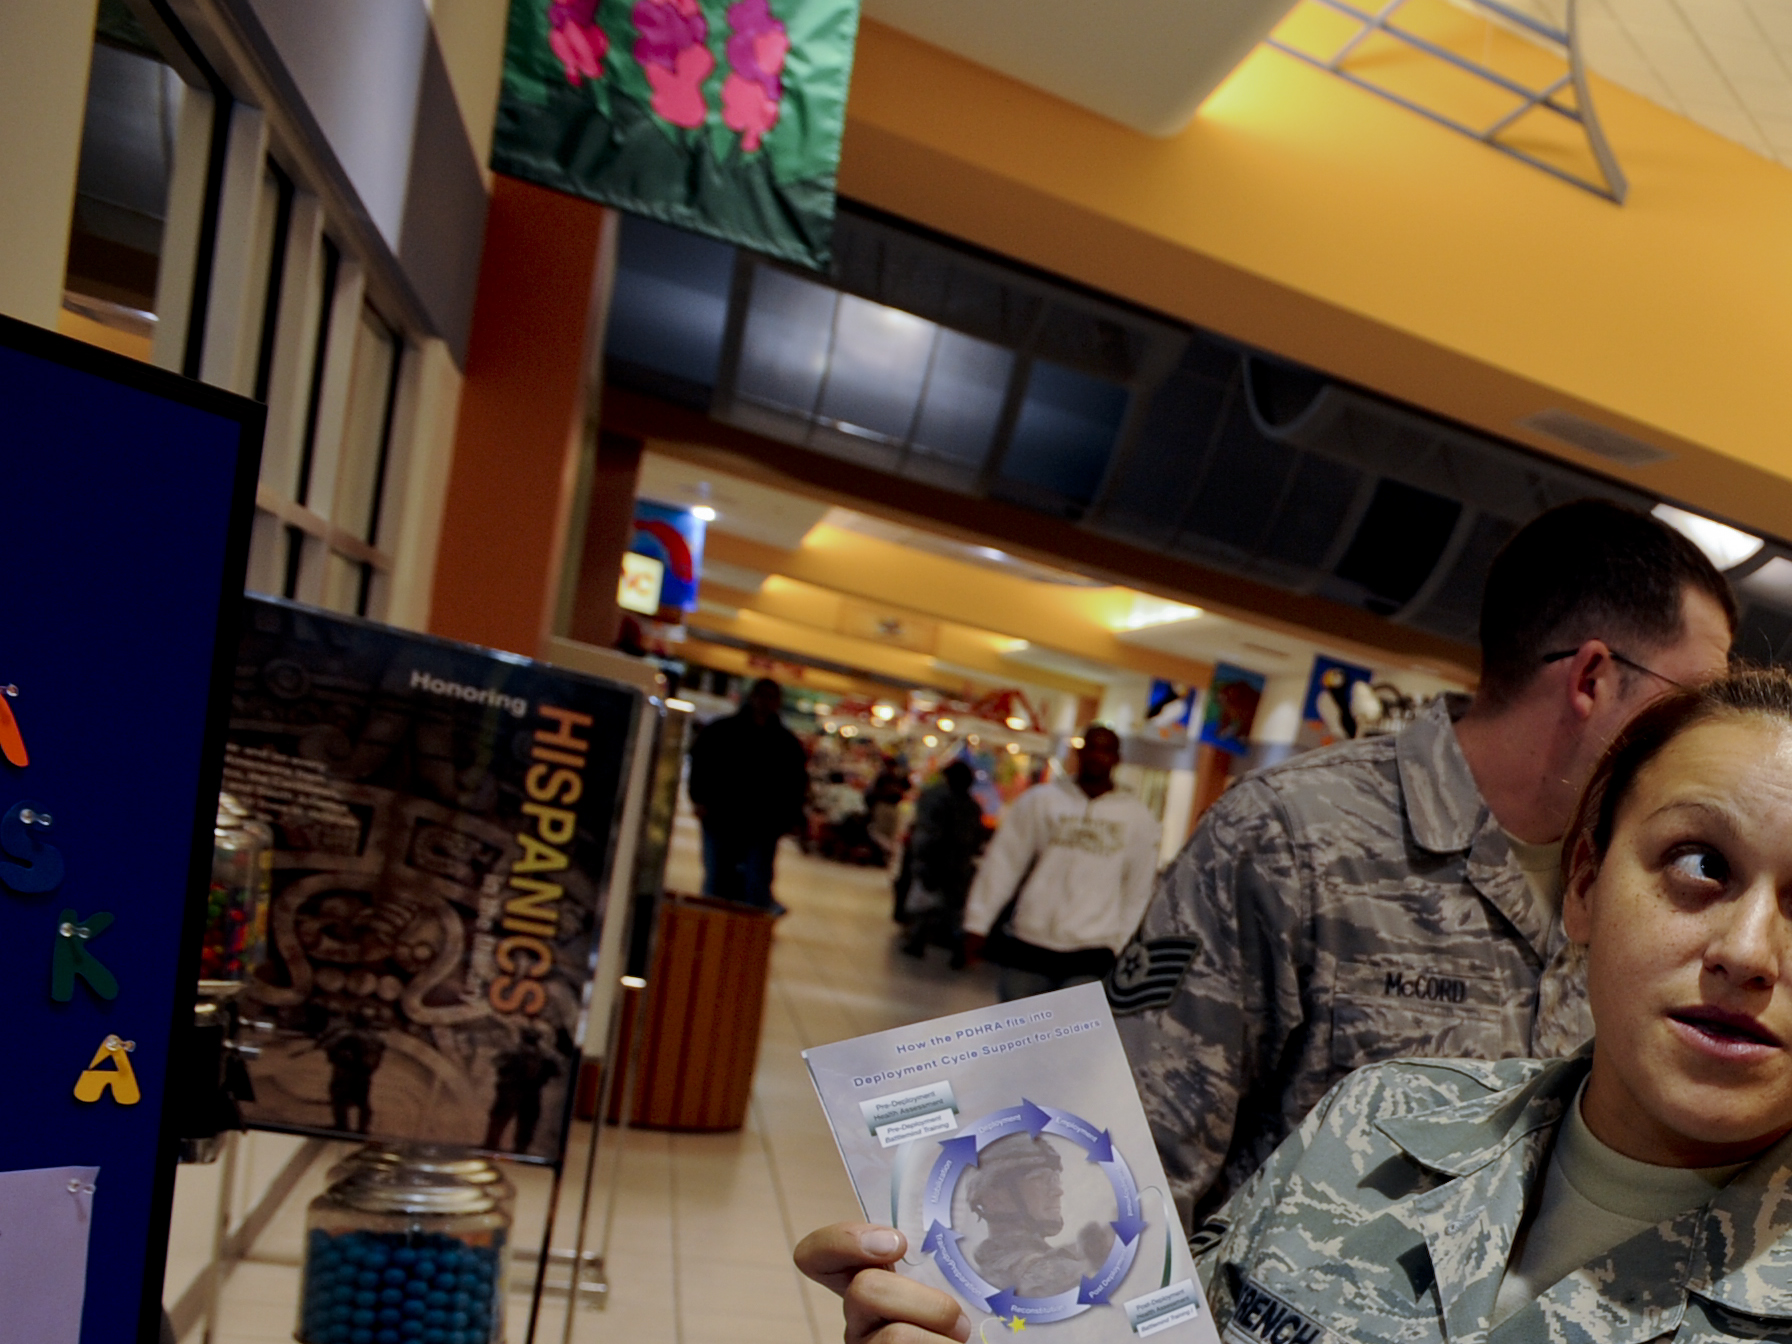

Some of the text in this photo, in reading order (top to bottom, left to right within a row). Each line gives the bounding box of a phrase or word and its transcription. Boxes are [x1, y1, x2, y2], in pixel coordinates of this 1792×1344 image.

[410, 670, 528, 718] Honoring
[489, 703, 593, 1017] HISPANICS
[1384, 971, 1466, 1003] McCORD
[896, 1010, 1052, 1054] How the PDHRA fits into
[853, 1019, 1100, 1087] Deployment Cycle Support for Soldiers
[874, 1098, 944, 1121] Health Assessment
[875, 1090, 936, 1112] Pre-Deployment
[887, 1114, 942, 1135] Pre-Deployment
[923, 1121, 950, 1136] Training
[978, 1113, 1022, 1134] Deployment
[1055, 1116, 1098, 1143] Employment
[931, 1160, 952, 1204] Mobilization
[1088, 1284, 1104, 1300] Post
[1136, 1288, 1185, 1311] Post-Deployment
[1011, 1303, 1066, 1315] Reconstitution
